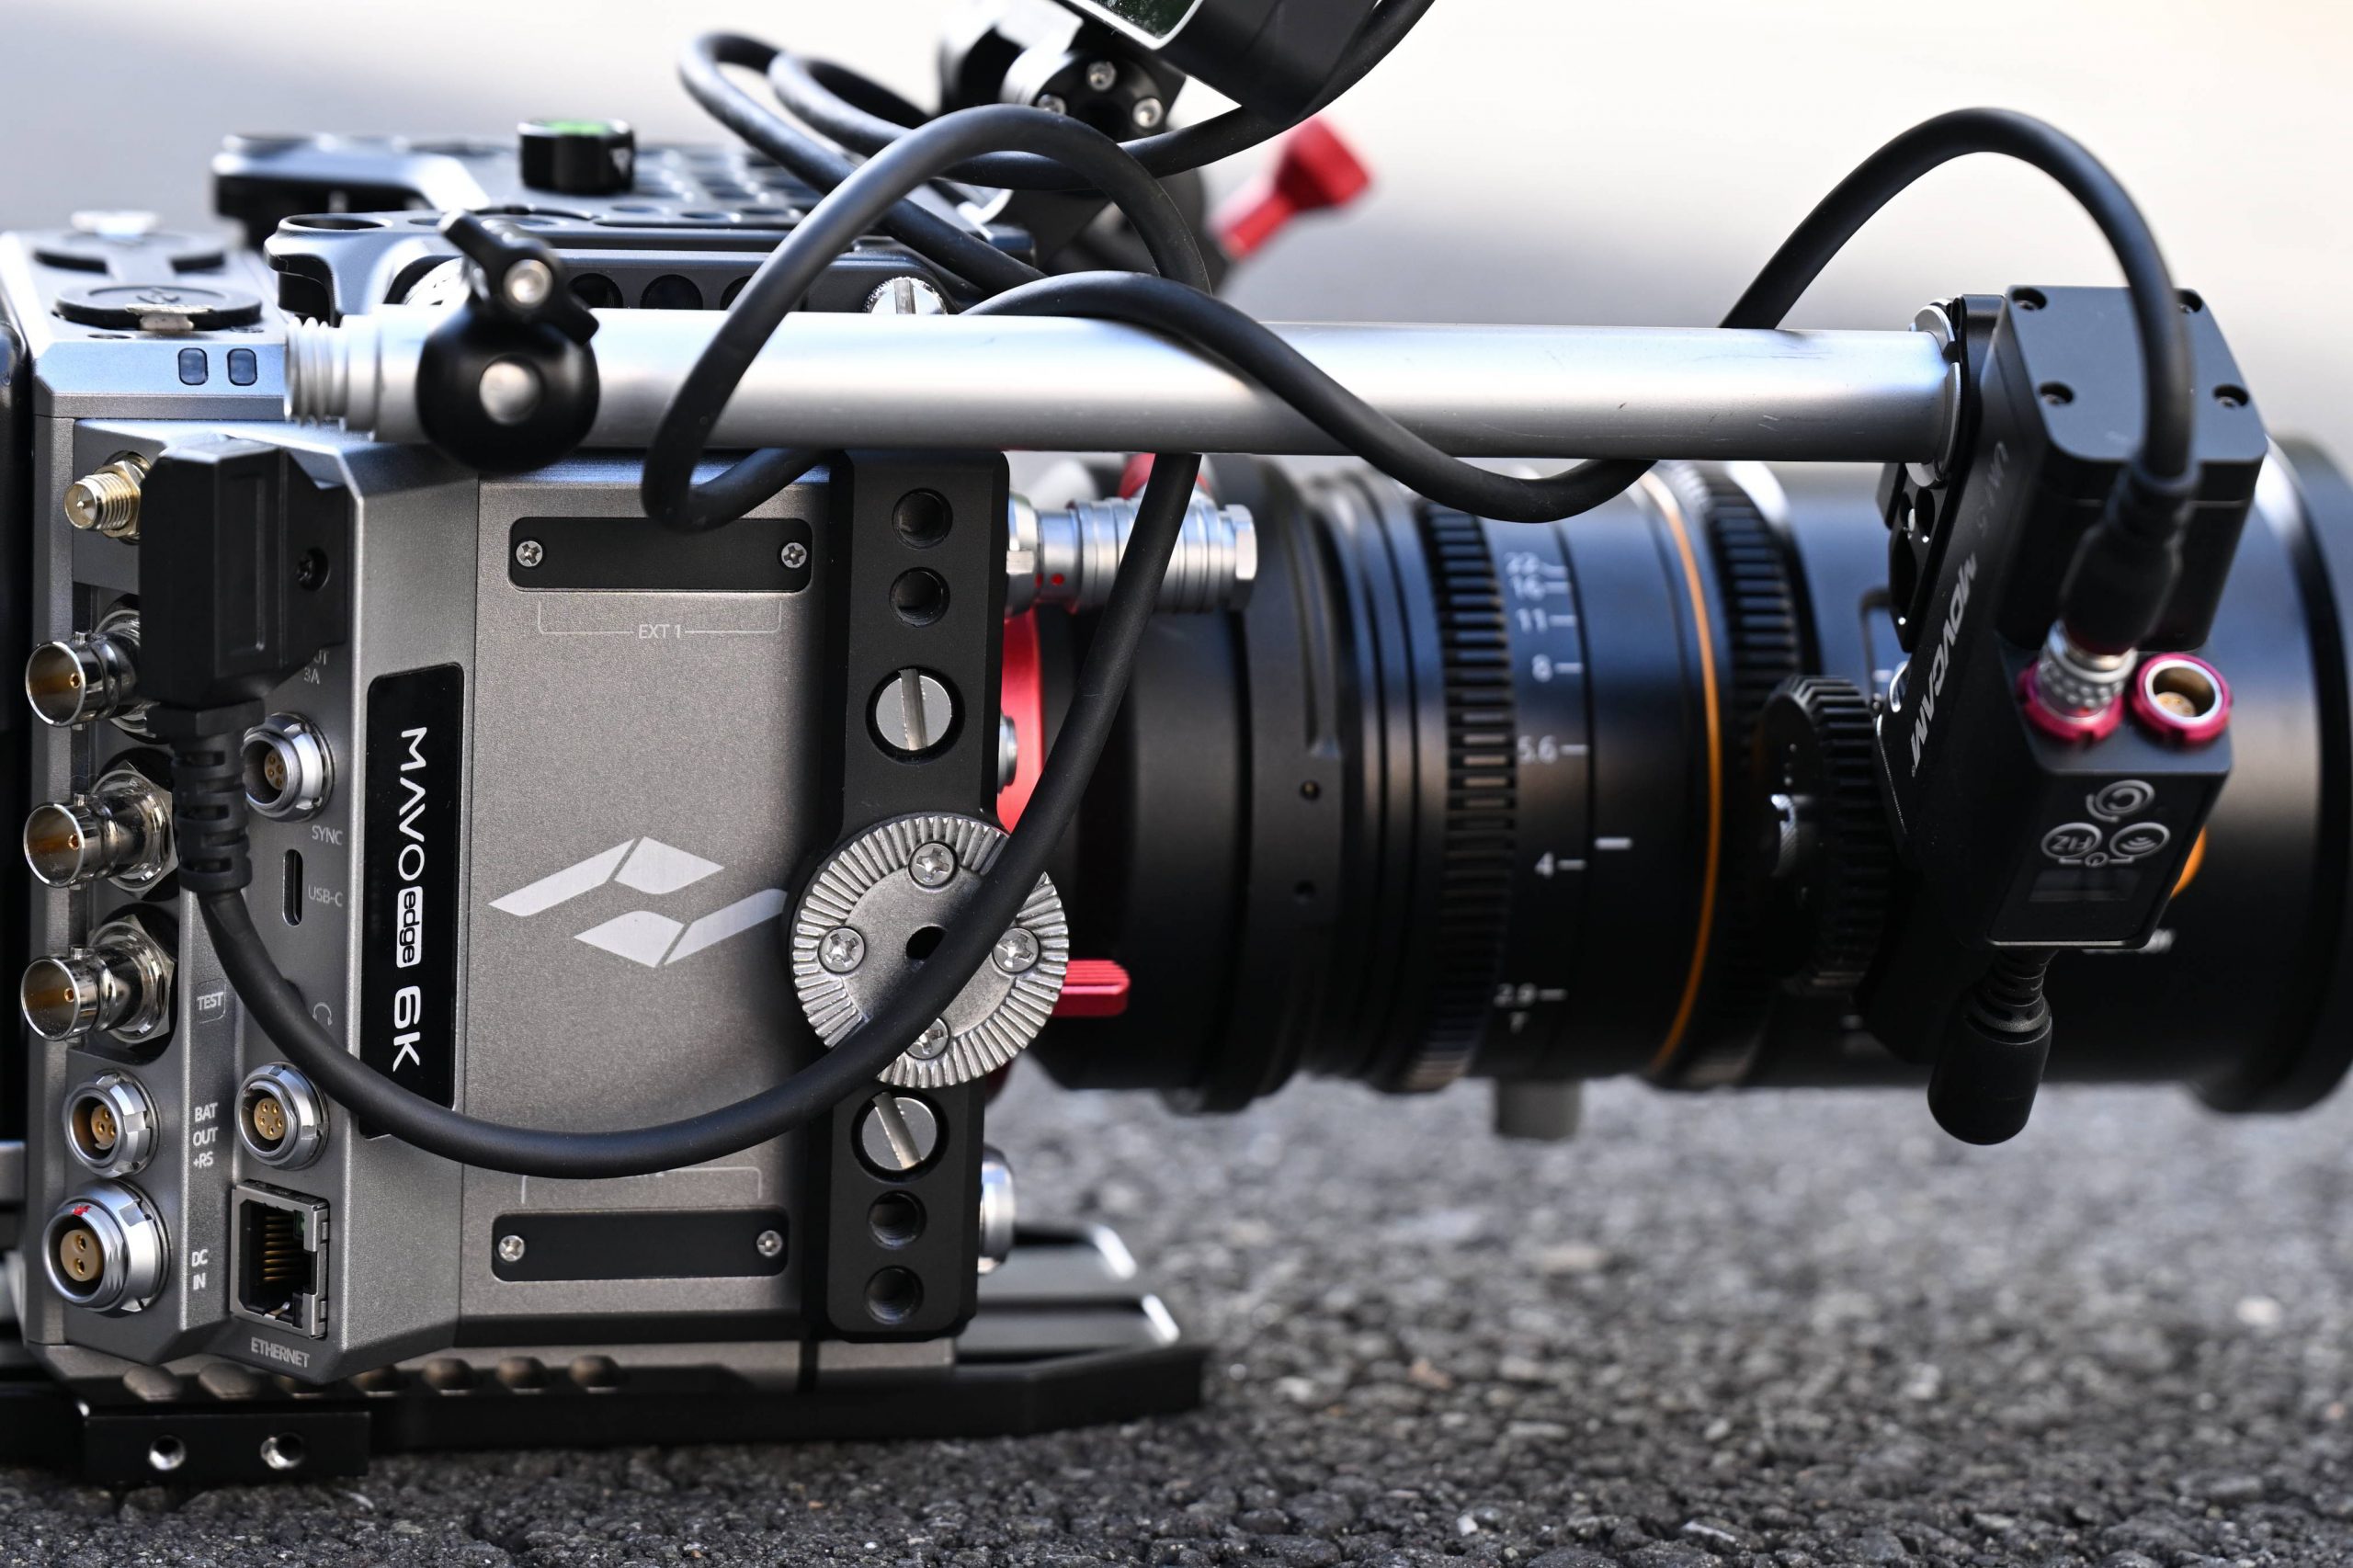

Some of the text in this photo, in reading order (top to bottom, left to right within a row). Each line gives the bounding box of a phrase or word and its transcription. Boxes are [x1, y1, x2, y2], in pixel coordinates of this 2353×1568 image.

[1516, 607, 1548, 634] 11
[638, 623, 682, 640] EXT 1
[1531, 653, 1553, 684] 8
[312, 824, 344, 846] SYNC
[1534, 851, 1555, 880] 4
[308, 883, 344, 908] USB-C
[392, 726, 427, 1073] MAVO edge 6K
[197, 991, 224, 1011] TEST
[194, 1102, 219, 1122] BAT
[192, 1126, 219, 1147] OUT
[193, 1151, 214, 1169] +RS
[191, 1248, 209, 1267] DC
[193, 1272, 206, 1290] IN
[250, 1335, 311, 1369] ETHERNET
